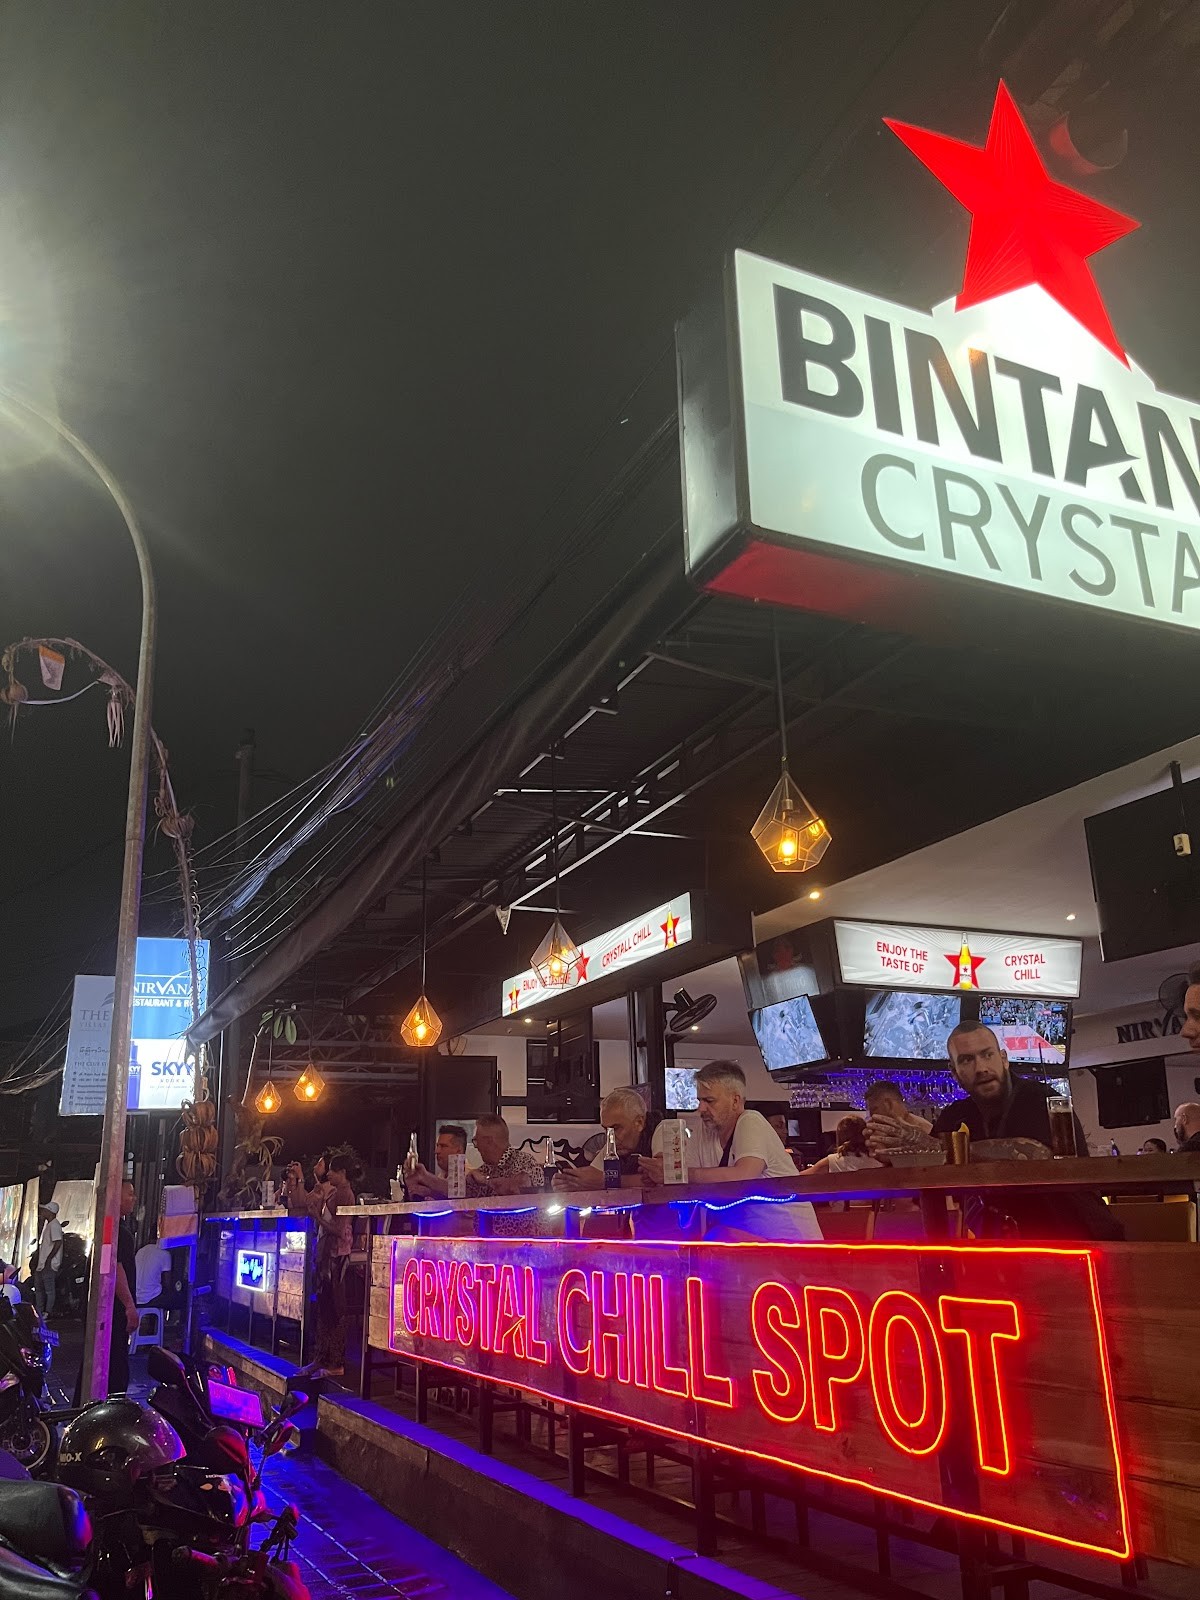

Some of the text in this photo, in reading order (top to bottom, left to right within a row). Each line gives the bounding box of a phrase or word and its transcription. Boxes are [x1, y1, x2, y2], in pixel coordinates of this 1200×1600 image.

[772, 283, 1200, 519] BINTAN
[602, 923, 652, 967] CRYSTALL CHILL
[876, 941, 929, 962] ENJOY THE
[880, 956, 925, 975] TASTE OF
[1004, 953, 1046, 967] CRYSTAL
[1014, 968, 1041, 981] CHILL
[132, 998, 175, 1008] ESTAURANT
[80, 1009, 110, 1021] THE
[404, 1257, 1021, 1476] CRYSTAL CHILL SPOT
